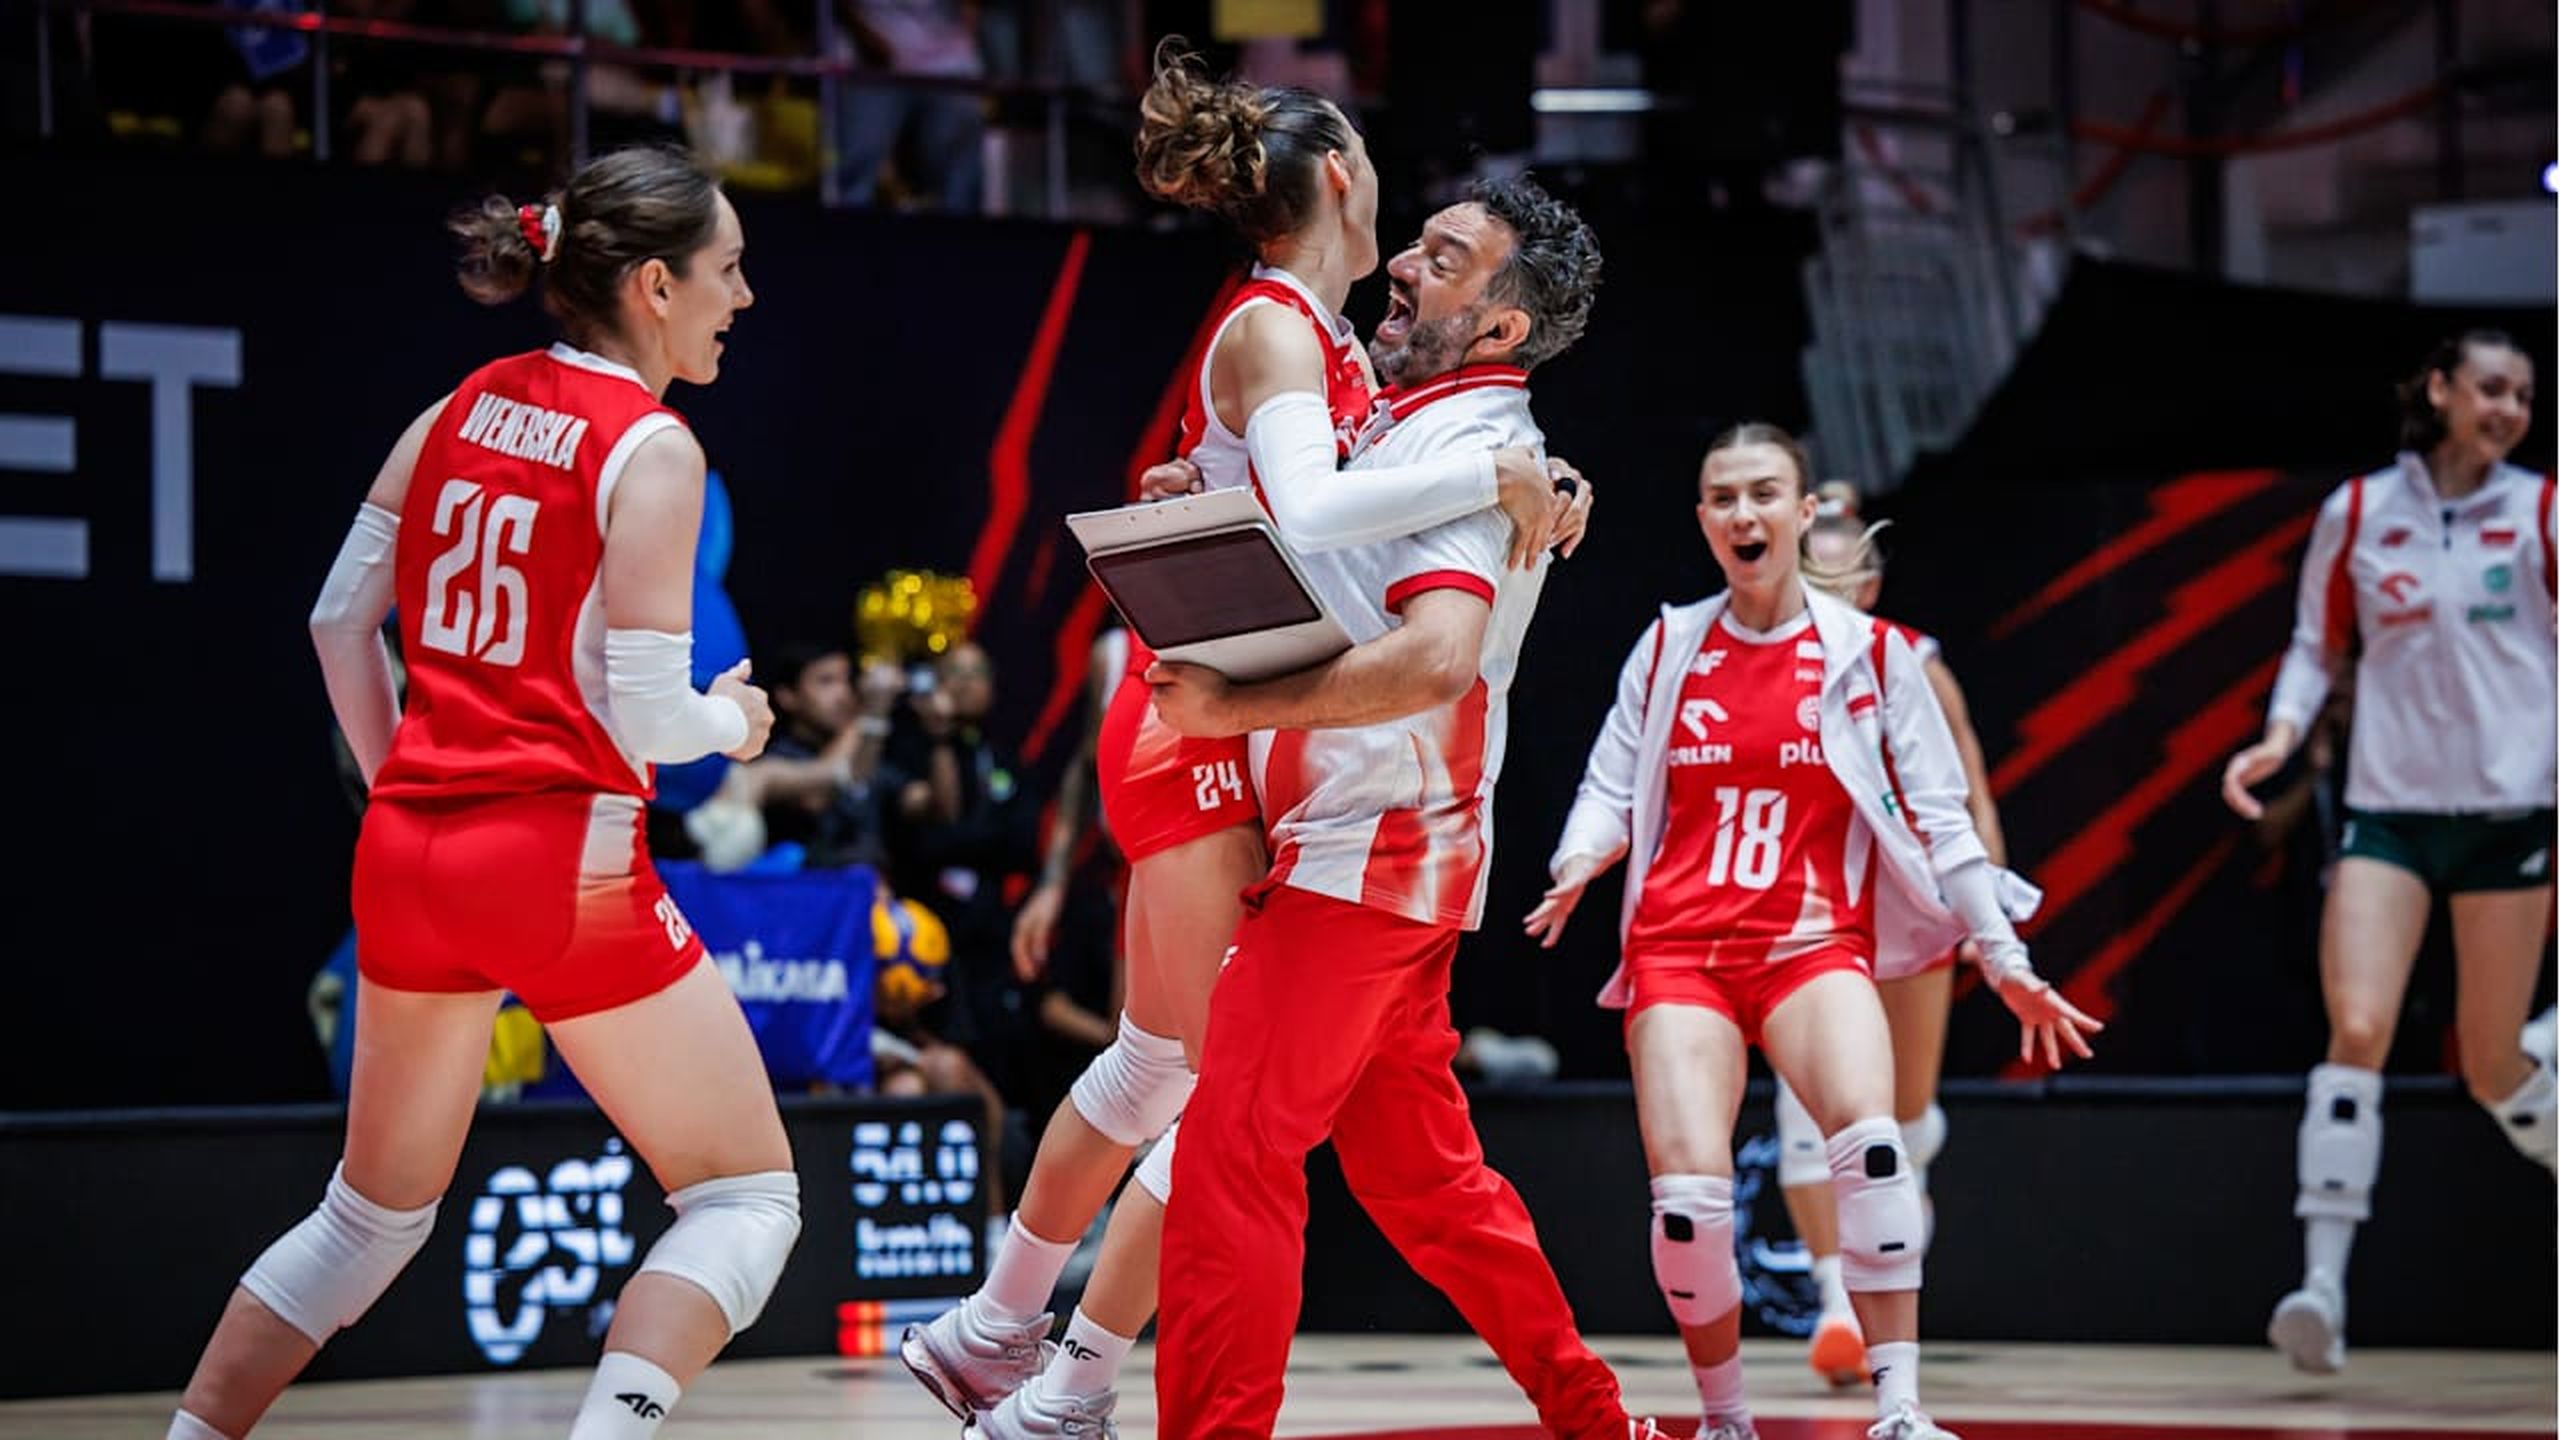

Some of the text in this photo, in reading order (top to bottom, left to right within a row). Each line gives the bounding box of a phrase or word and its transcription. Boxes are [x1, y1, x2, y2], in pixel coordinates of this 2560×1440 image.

[458, 391, 589, 470] WENERSKA
[420, 478, 541, 667] 26
[1192, 759, 1243, 811] 24
[1780, 737, 1826, 768] plu
[1707, 785, 1788, 889] 18
[850, 1120, 979, 1206] 54.0
